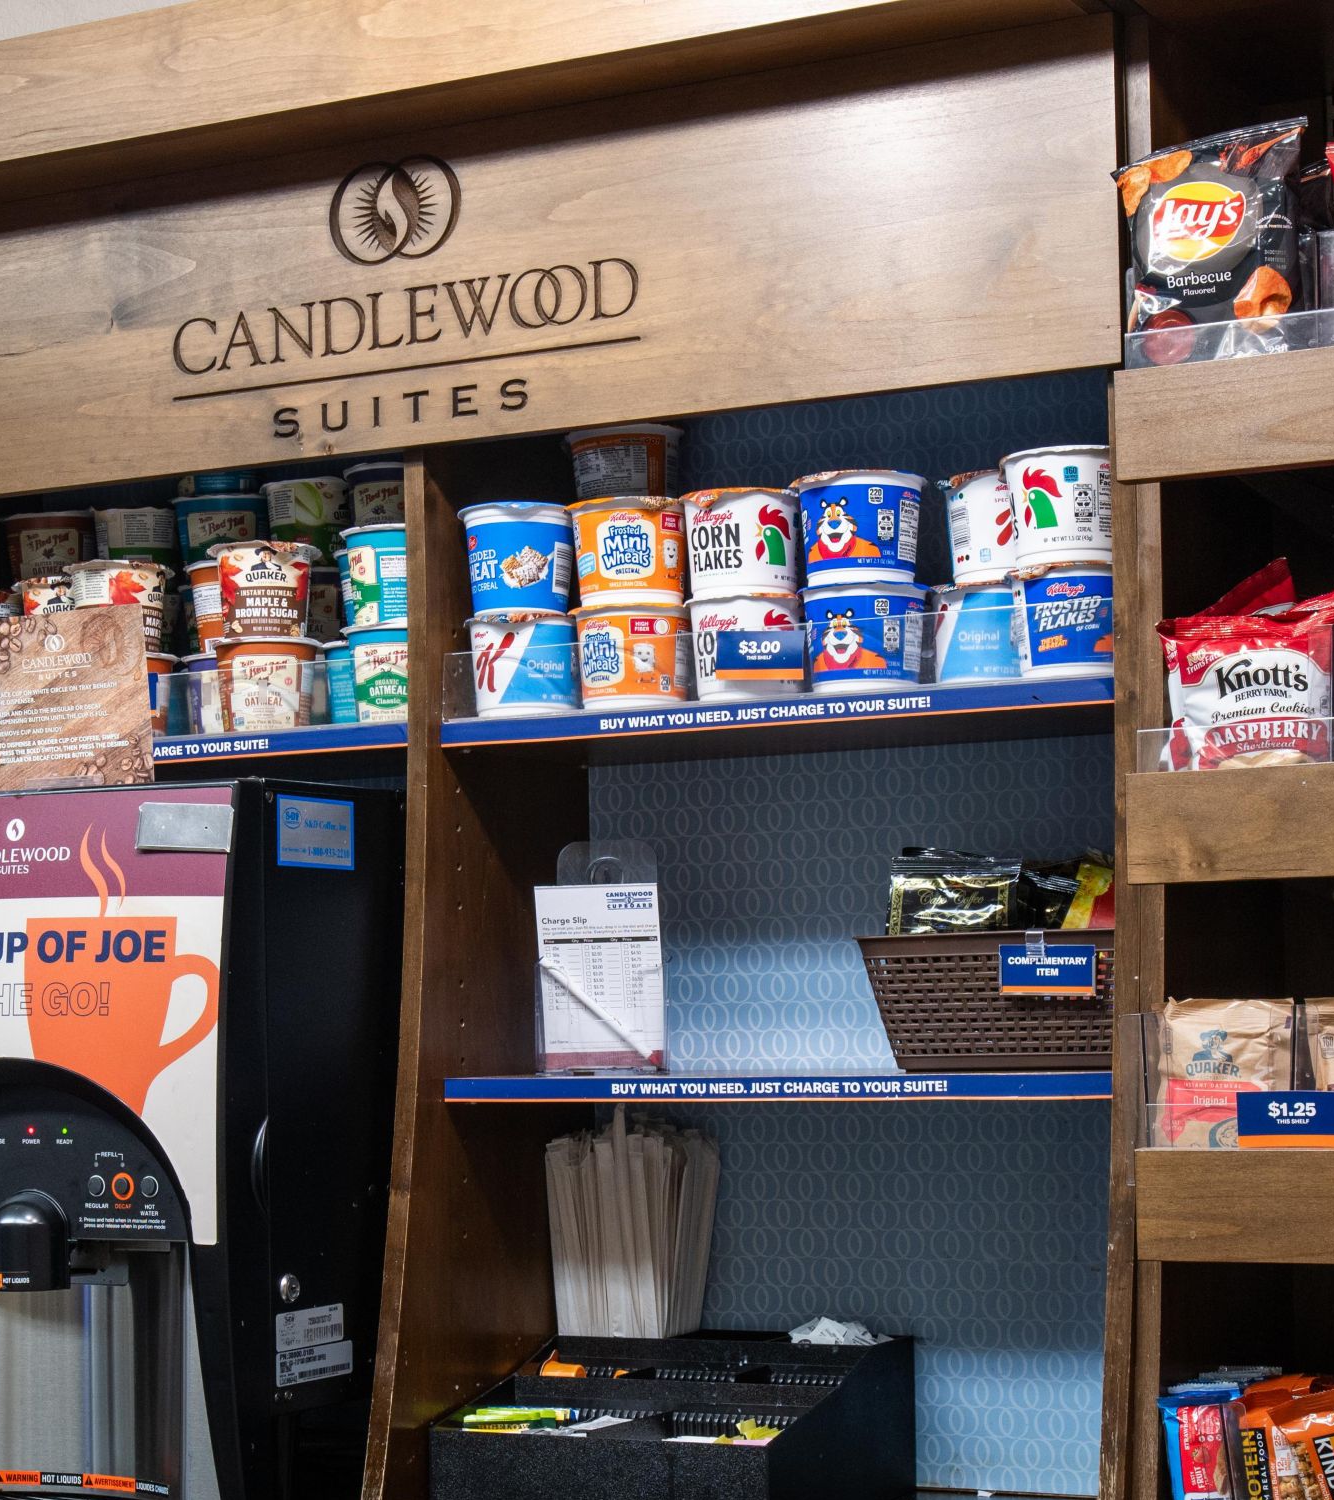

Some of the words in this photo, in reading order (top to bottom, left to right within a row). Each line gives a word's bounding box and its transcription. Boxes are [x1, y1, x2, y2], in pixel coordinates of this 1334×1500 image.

[1154, 197, 1242, 240] Lay's
[1166, 270, 1232, 289] Barbecue
[1182, 286, 1217, 297] Flavored
[172, 257, 640, 376] CANDLEWOOD
[272, 378, 529, 439] SUITES
[608, 525, 642, 537] Frosted
[691, 522, 741, 552] CORN
[604, 532, 650, 553] Mini
[602, 550, 651, 570] Wheats
[693, 549, 743, 574] FLAKES
[245, 571, 287, 583] QUAKER
[246, 597, 279, 607] MAPLE
[280, 598, 288, 607] &
[1033, 595, 1102, 621] FROSTED
[235, 608, 269, 619] BROWN
[269, 608, 298, 619] SUGAR
[1038, 610, 1096, 633] FLAKES
[957, 630, 1000, 643] Original
[738, 640, 781, 655] $3.00
[527, 658, 565, 673] Original
[1214, 658, 1310, 700] Knott's
[369, 685, 407, 697] OATMEAL
[1234, 688, 1264, 704] BERRY
[1263, 686, 1288, 699] FARM
[599, 718, 626, 731] BUY
[628, 715, 665, 728] WHAT
[666, 712, 695, 726] YOU
[695, 710, 734, 724] NEED.
[736, 707, 768, 721] JUST
[769, 704, 825, 719] CHARGE
[828, 702, 846, 714] TO
[847, 699, 885, 713] YOUR
[886, 695, 932, 711] SUITE!
[1211, 704, 1267, 724] Premium
[1270, 701, 1316, 715] Cookies
[1212, 720, 1323, 748] RASPBERRY
[541, 916, 571, 926] Charge
[572, 916, 588, 925] Slip
[37, 930, 87, 964] OF
[94, 929, 167, 964] JOE
[1007, 956, 1088, 966] COMPLIMENTARY
[1036, 968, 1059, 977] ITEM
[41, 982, 111, 1018] GO!
[1185, 1061, 1241, 1078] QUAKER
[611, 1083, 637, 1095] BUY
[639, 1082, 677, 1095] WHAT
[678, 1082, 707, 1095] YOU
[709, 1082, 748, 1095] NEED.
[749, 1082, 782, 1094] JUST
[783, 1081, 841, 1094] CHARGE
[841, 1081, 860, 1093] TO
[862, 1080, 901, 1093] YOUR
[903, 1079, 949, 1093] SUITE!
[1192, 1094, 1228, 1106] Original
[1267, 1101, 1317, 1119] $1.25
[5, 1474, 39, 1483] WARNING
[41, 1474, 56, 1484] HOT
[56, 1475, 82, 1485] LIQUIDS
